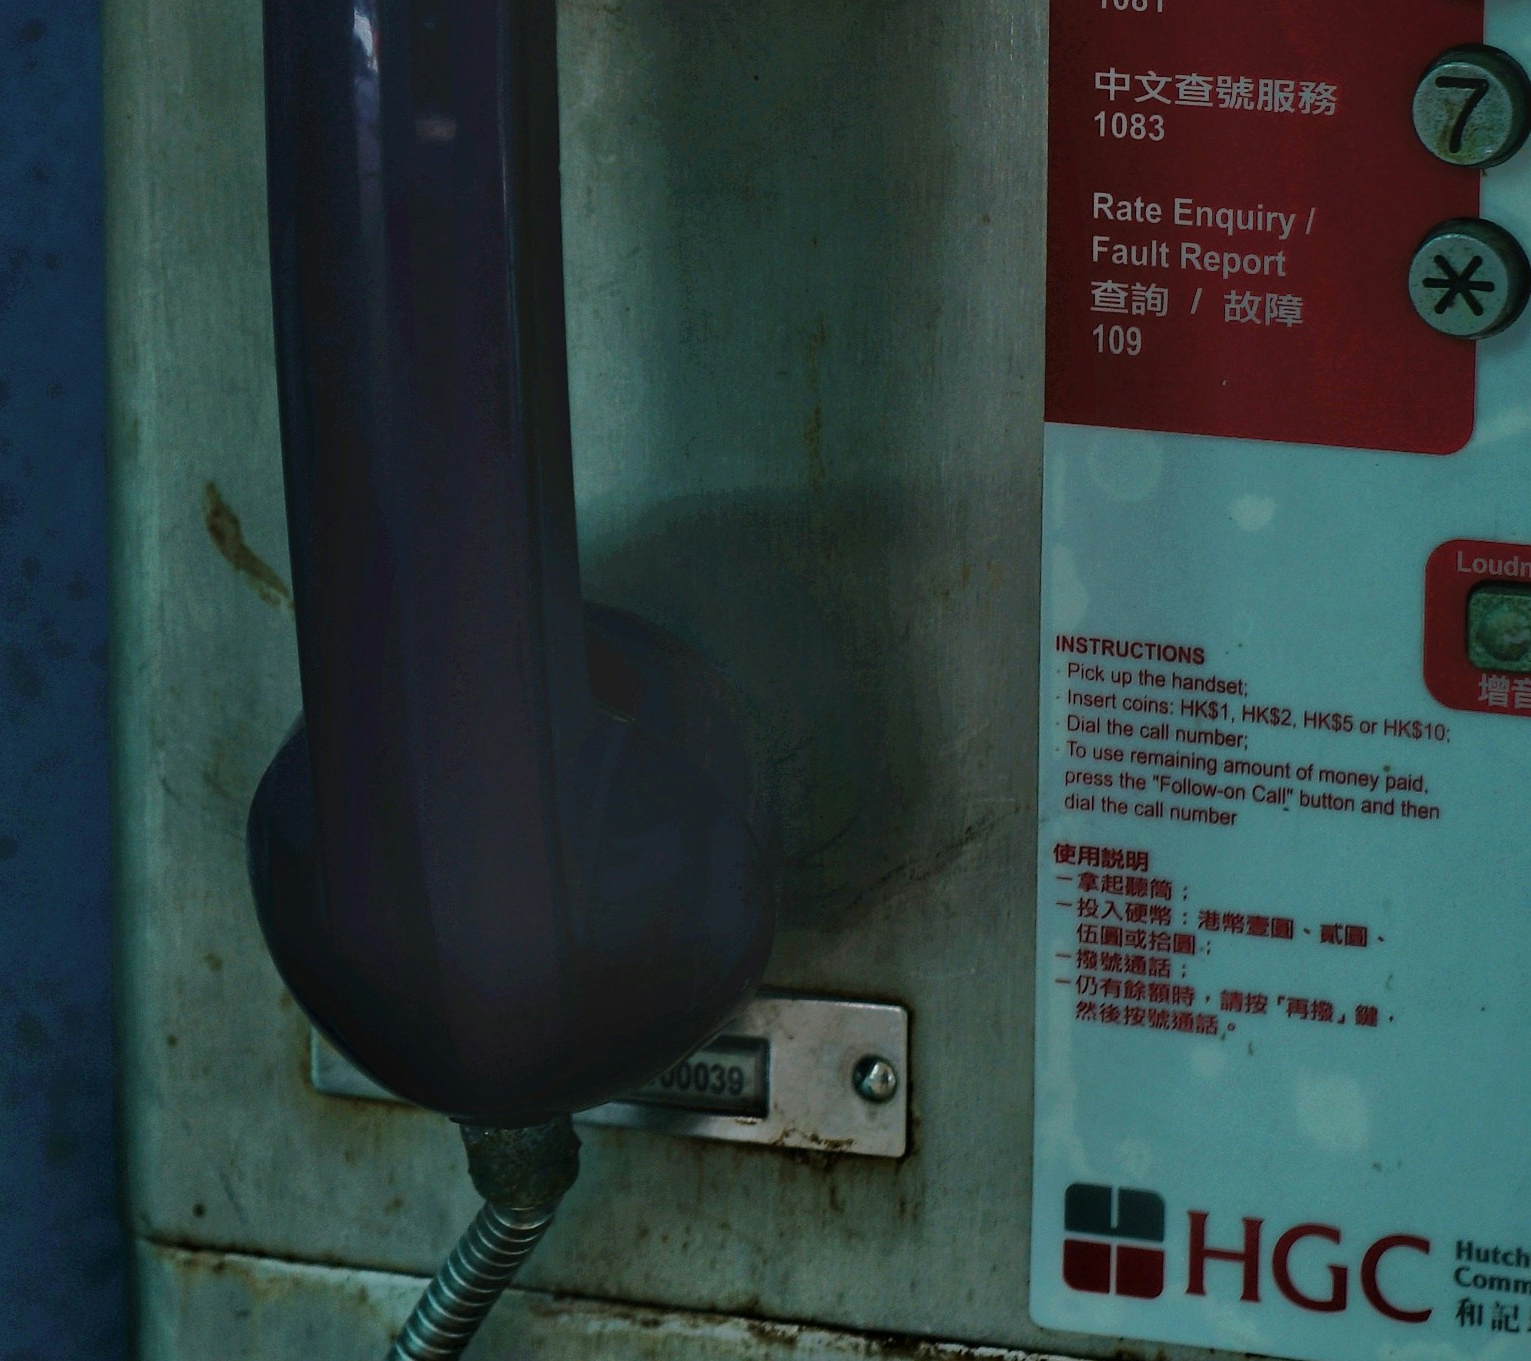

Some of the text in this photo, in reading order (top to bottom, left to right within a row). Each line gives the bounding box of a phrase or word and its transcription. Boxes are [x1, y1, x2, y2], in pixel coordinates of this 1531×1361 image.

[1094, 67, 1337, 116] 中文查號服務
[1435, 75, 1490, 153] 7
[1094, 111, 1165, 141] 1083
[1093, 192, 1162, 223] Rate
[1173, 197, 1296, 239] Enquiry
[1092, 235, 1286, 279] Fault Report
[1090, 279, 1169, 318] 查詢
[1223, 290, 1304, 328] 故障
[1092, 323, 1142, 356] 109
[1055, 635, 1206, 665] INSTRUCTIONS
[1068, 662, 1248, 697] Pick up the handset;
[1067, 714, 1249, 751] Dial the call number;
[1068, 689, 1451, 743] Insert coins: HK$1, HK$2, HK$5 or HK$10;
[1067, 740, 1429, 795] To use remaining amount of money paid,
[1064, 793, 1238, 826] dial the call number
[1065, 770, 1440, 820] press the "Follow-on Call" button and then
[1185, 1209, 1432, 1323] HGC
